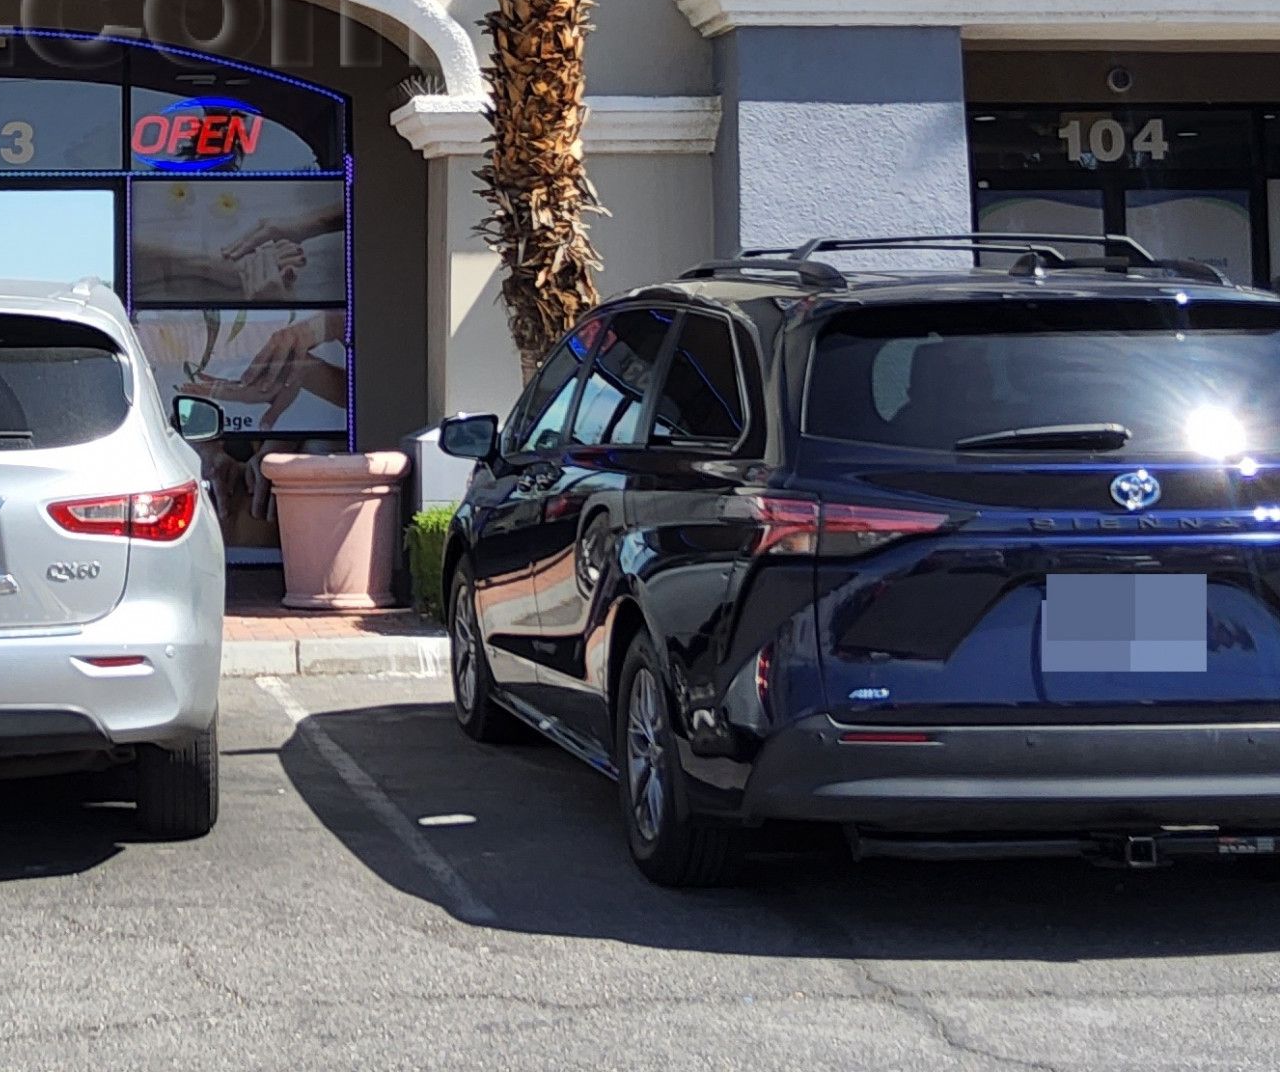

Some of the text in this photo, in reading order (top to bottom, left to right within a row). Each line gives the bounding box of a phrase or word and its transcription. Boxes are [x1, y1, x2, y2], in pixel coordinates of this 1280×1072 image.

[131, 115, 263, 154] OPEN
[1058, 118, 1169, 163] 104
[46, 560, 101, 583] QX60
